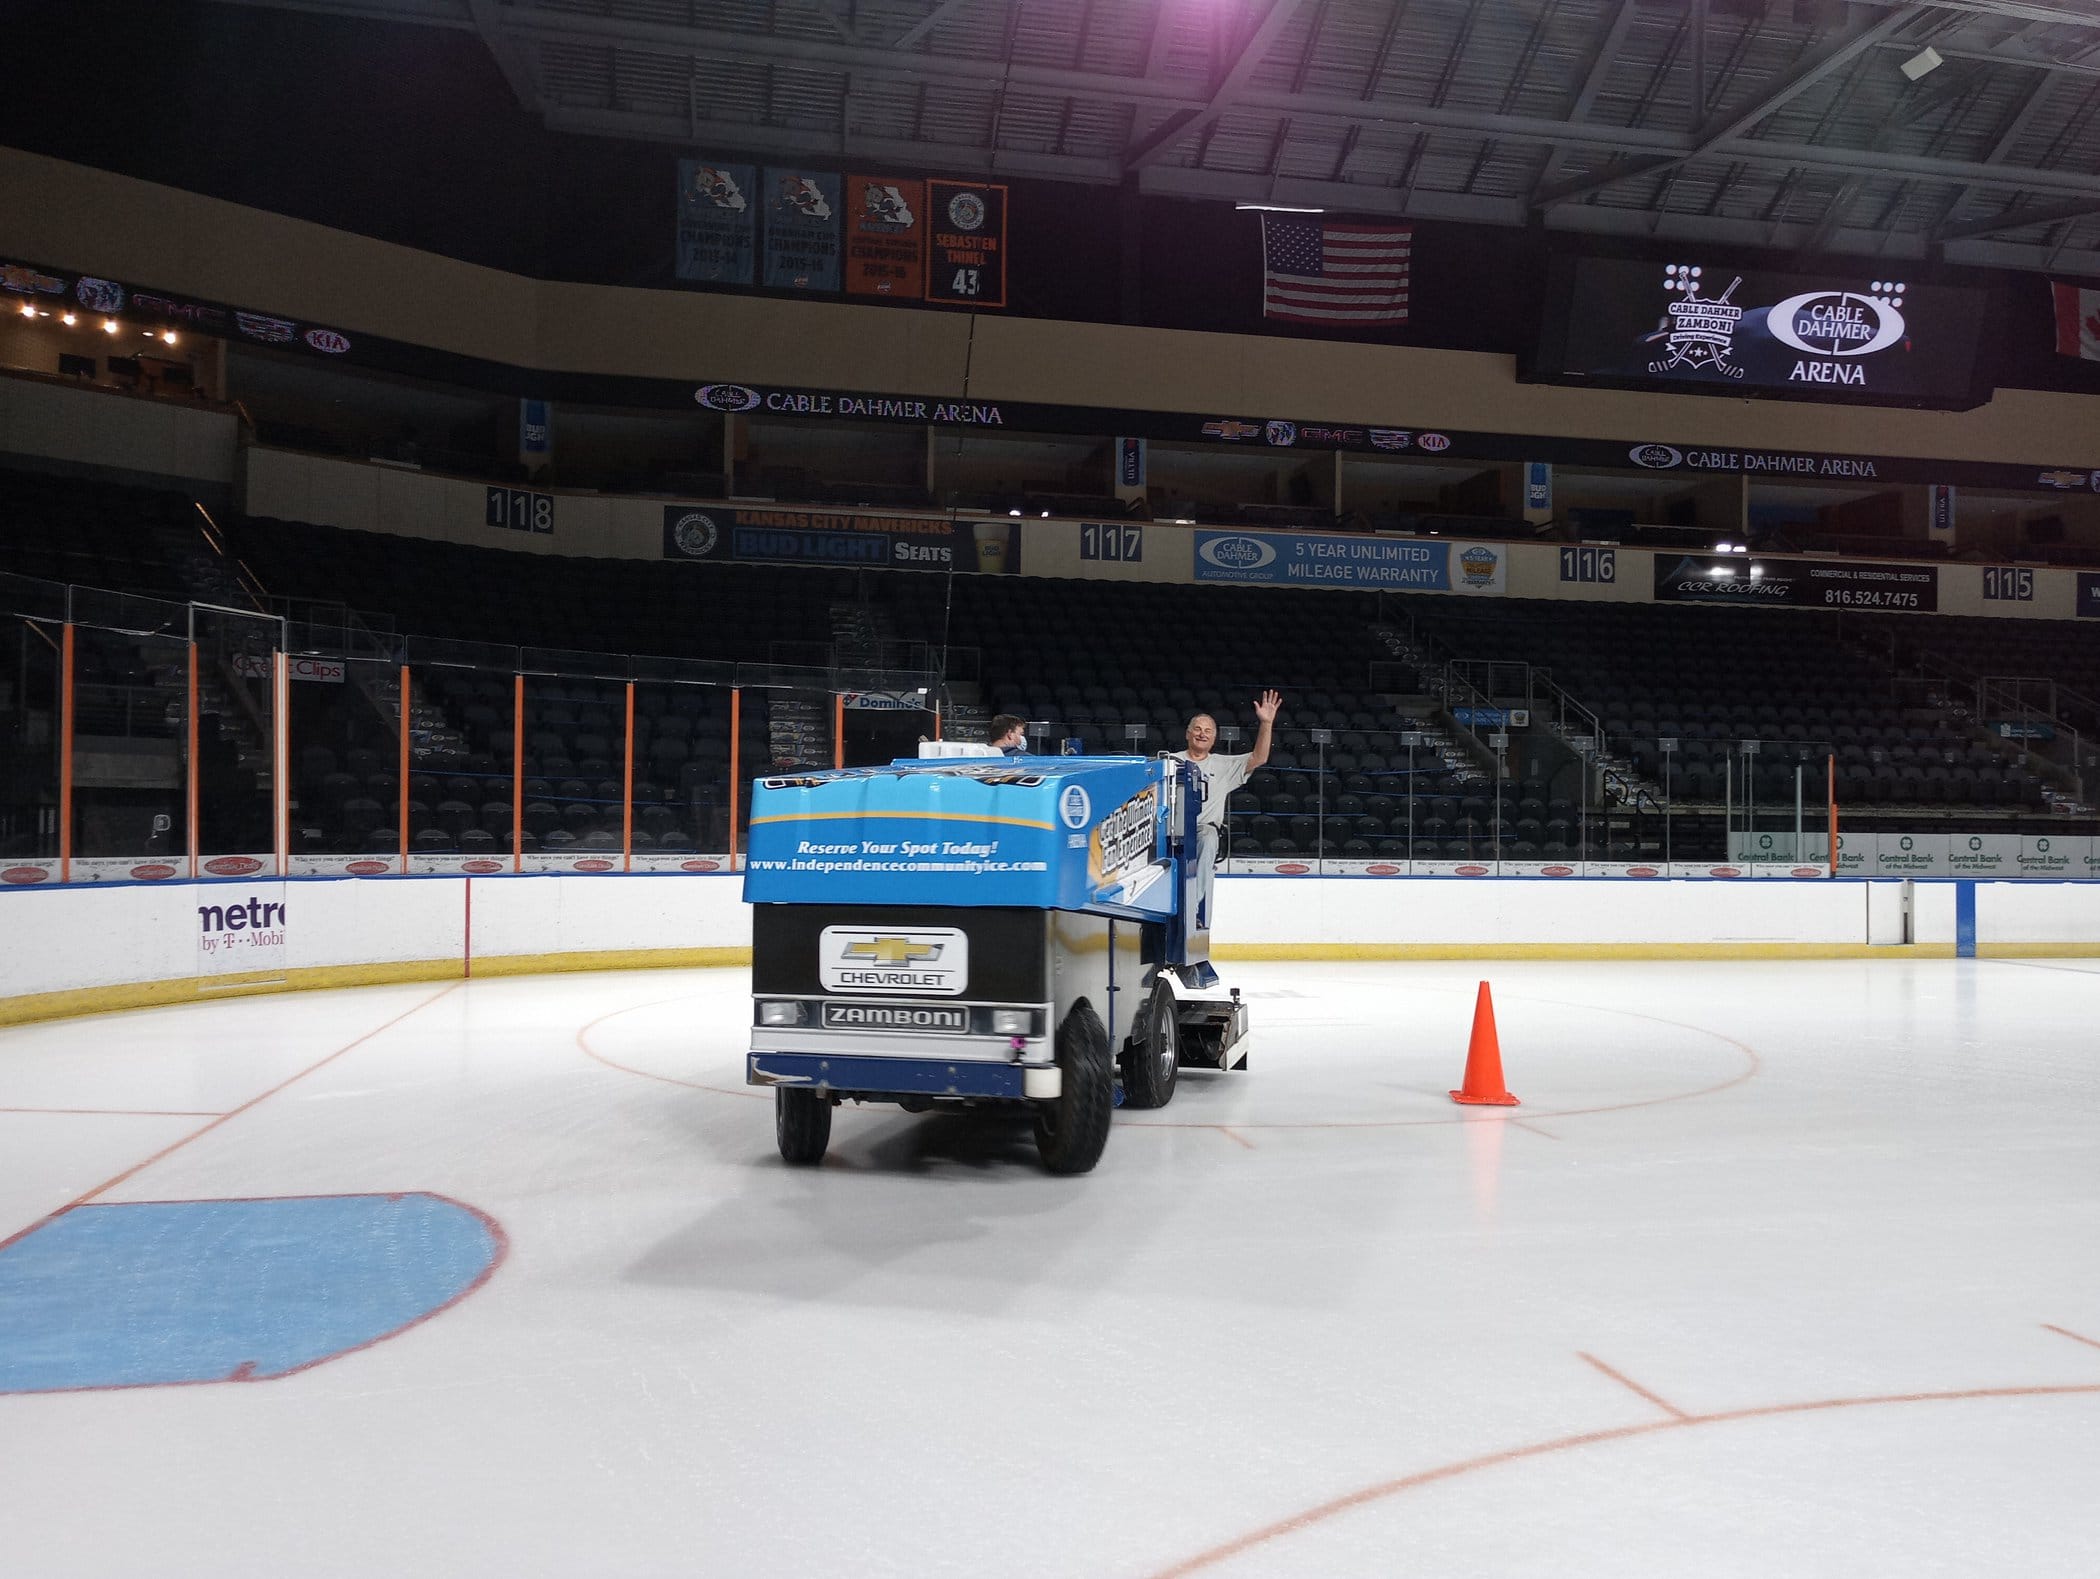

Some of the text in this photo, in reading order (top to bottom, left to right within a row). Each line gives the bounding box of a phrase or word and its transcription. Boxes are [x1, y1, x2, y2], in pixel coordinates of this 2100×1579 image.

[952, 268, 980, 295] 43
[1670, 304, 1740, 317] CABLE DAHMER
[1811, 304, 1864, 324] CABLE
[1678, 318, 1732, 332] ZAMBONI
[1798, 319, 1871, 341] DAHMER
[312, 331, 344, 351] KIA
[1788, 360, 1866, 386] ARENA
[766, 393, 1004, 425] CABLE DAHMER ARENA
[1301, 427, 1364, 443] GMC
[1423, 436, 1447, 449] KIA
[1686, 452, 1878, 477] CABLE DAHMER ARENA
[490, 492, 552, 530] 118
[736, 511, 952, 536] KANSAS CITY MAVERICKS
[739, 531, 798, 556] BUD
[802, 534, 885, 561] LIGHT
[895, 541, 952, 563] SEATS
[1084, 527, 1141, 558] 117
[1223, 543, 1253, 553] CABLE
[1217, 551, 1258, 561] DAHMER
[1295, 543, 1430, 562] 5 YEAR UNLIMITED
[1288, 563, 1439, 583] MILEAGE WARRANTY
[1563, 551, 1614, 580] 116
[1809, 569, 1852, 579] COMMERCIAL
[1899, 573, 1930, 582] SERVICES
[1986, 570, 2032, 598] 115
[1677, 581, 1790, 597] CCR ROOFING
[1825, 589, 1919, 607] 816.524.7475
[296, 660, 342, 680] Clips
[860, 697, 921, 710] Domino's
[798, 841, 998, 858] Reserve Your Spot Today!
[1771, 852, 1794, 863] Bank
[1843, 853, 1865, 863] Bank
[1879, 853, 1934, 863] Central Bank
[1948, 853, 2002, 863] Central Bank
[750, 858, 1047, 875] www.independencecommunityice.com
[2016, 855, 2070, 865] Central Bank
[202, 934, 219, 955] by
[840, 972, 946, 986] CHEVROLET
[830, 1008, 962, 1027] ZAMBONI
